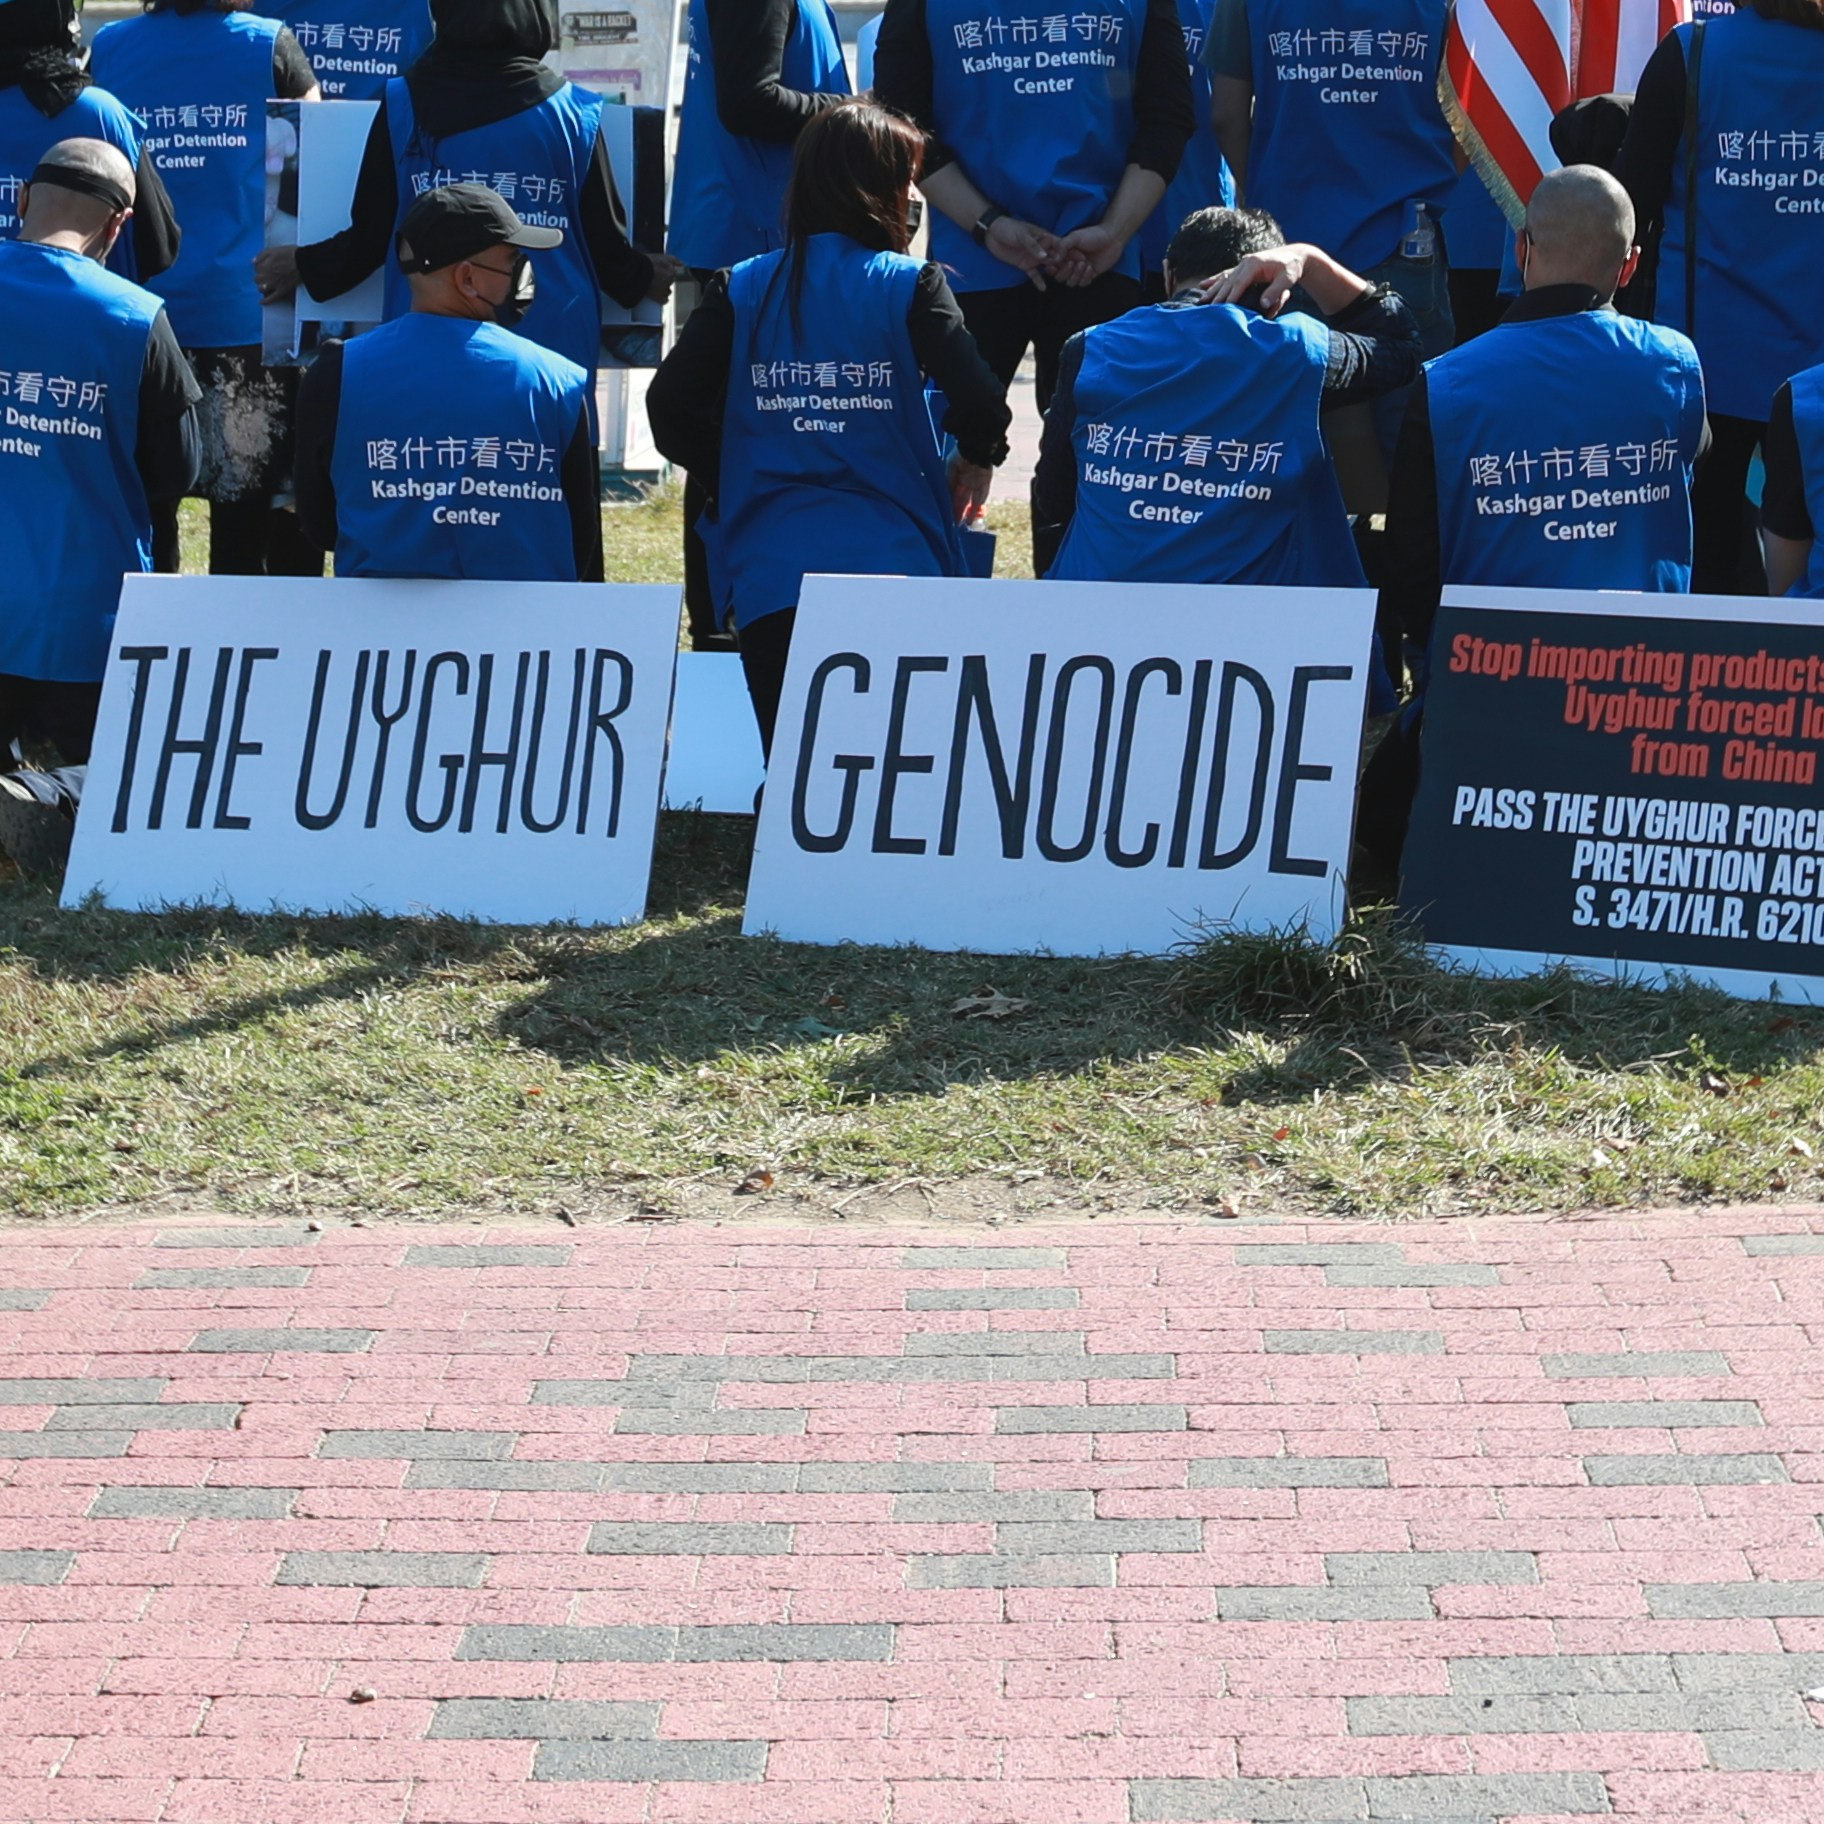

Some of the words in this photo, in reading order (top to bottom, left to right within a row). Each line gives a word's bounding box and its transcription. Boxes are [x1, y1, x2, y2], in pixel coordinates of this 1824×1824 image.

[294, 20, 403, 55] 市看守所
[952, 12, 1125, 50] 喀什市看守所
[1268, 27, 1430, 61] 喀什市看守所
[313, 55, 398, 77] Detention
[962, 51, 1031, 75] Kashgar
[1341, 62, 1424, 83] Detention
[1014, 76, 1075, 95] Center
[1320, 87, 1379, 104] Center
[133, 104, 248, 130] 什市看守所
[173, 132, 247, 149] Detention
[155, 153, 206, 170] Center
[1714, 167, 1799, 192] Kashgar
[516, 210, 569, 229] ention
[750, 360, 894, 389] 喀什市看守所
[756, 394, 808, 413] Kashgar
[808, 393, 894, 411] Detention
[5, 406, 103, 441] Detention
[793, 416, 846, 434] Center
[1085, 422, 1285, 475] 喀什市看守所
[1469, 437, 1679, 488] 喀什市看守所
[371, 477, 456, 501] Kashgar
[460, 476, 564, 503] Detention
[1084, 462, 1159, 493] Kashgar
[1162, 471, 1273, 502] Detention
[1128, 499, 1204, 525] Center
[1476, 492, 1567, 517] Kashgar
[1571, 483, 1671, 510] Detention
[432, 504, 501, 527] Center
[1543, 520, 1618, 542] Center
[1448, 633, 1524, 681] Stop
[1527, 637, 1685, 693] importing
[1563, 684, 1682, 734] Uyghur
[1685, 690, 1797, 739] forced
[110, 645, 280, 834] THE
[294, 647, 634, 839] UYGHUR
[790, 651, 1354, 879] GENOCIDE
[1630, 732, 1711, 778] from
[1721, 738, 1818, 785] China
[1451, 784, 1537, 831] PASS
[1541, 791, 1600, 836] THE
[1601, 795, 1732, 845] UYGHUR
[1570, 838, 1767, 895] PREVENTION
[1571, 884, 1601, 928] S.
[1606, 887, 1750, 940] 3471/H.R.
